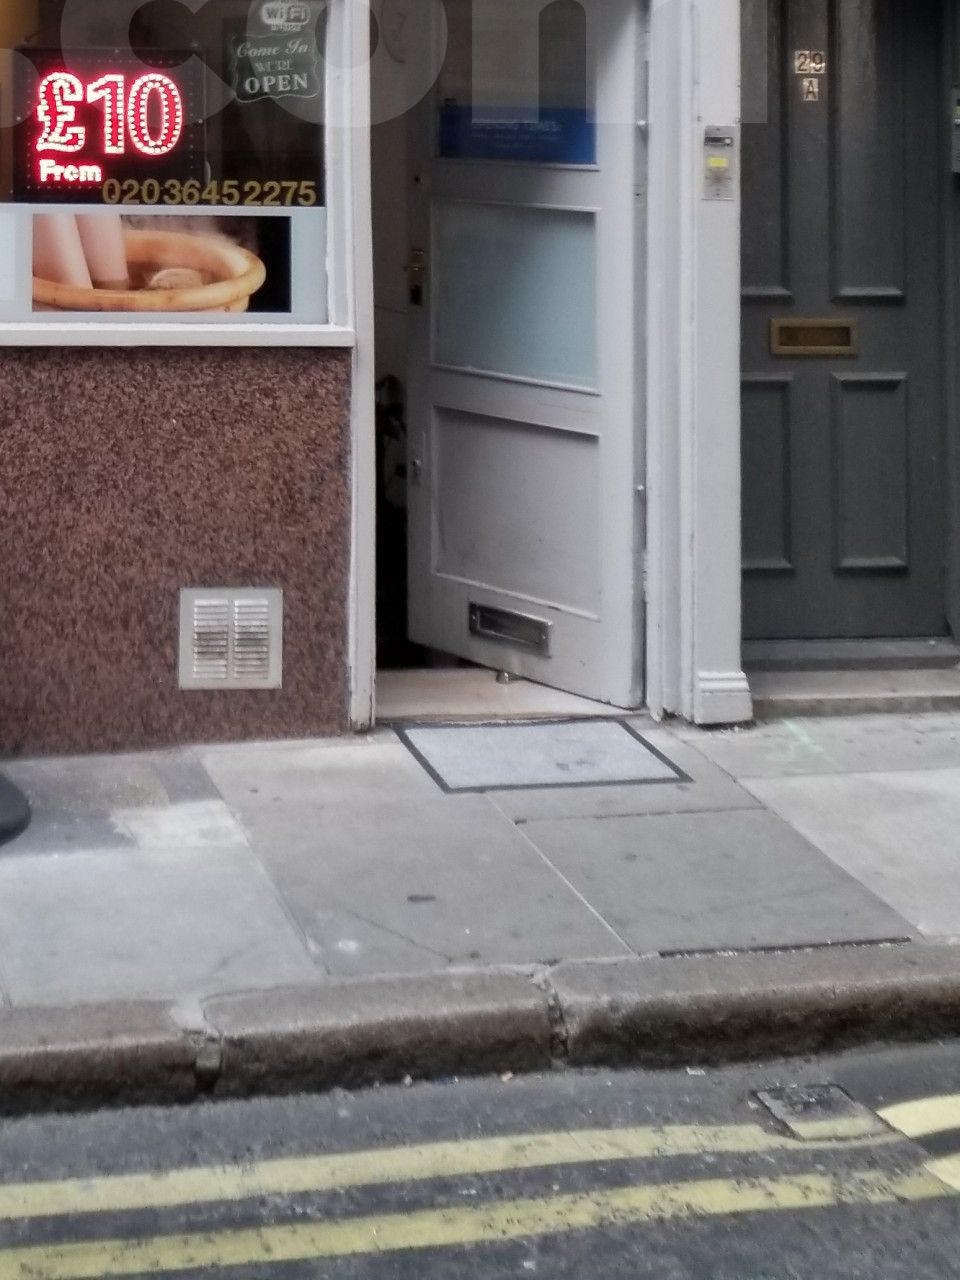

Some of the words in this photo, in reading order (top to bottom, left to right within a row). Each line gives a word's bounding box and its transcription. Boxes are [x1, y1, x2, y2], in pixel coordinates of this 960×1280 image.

[236, 41, 281, 58] Come
[286, 40, 309, 55] In
[798, 52, 823, 72] 29
[244, 73, 308, 94] OPEN
[805, 79, 817, 99] A
[36, 72, 182, 155] £10
[39, 159, 102, 182] From
